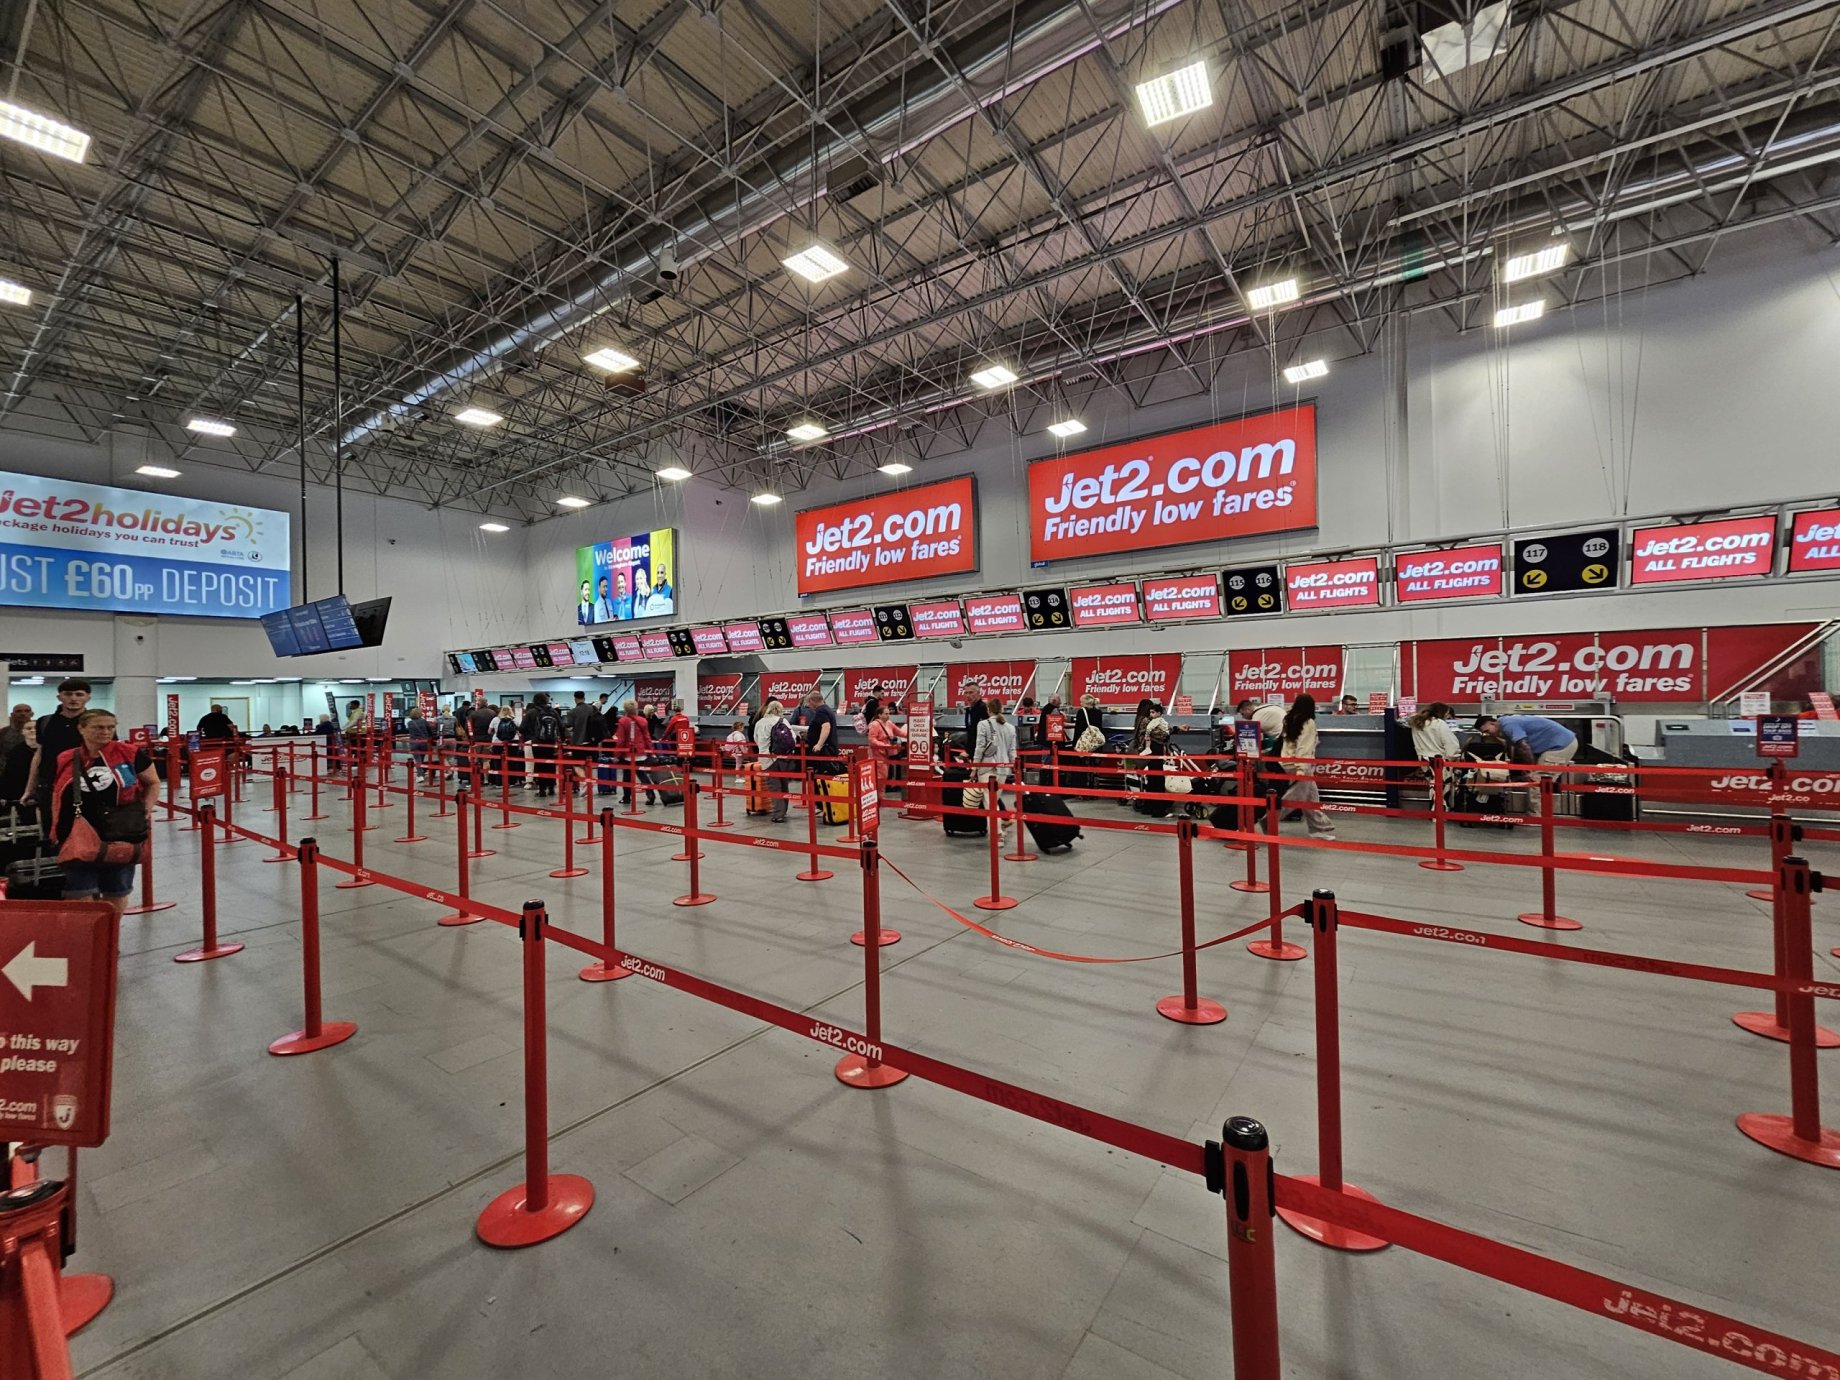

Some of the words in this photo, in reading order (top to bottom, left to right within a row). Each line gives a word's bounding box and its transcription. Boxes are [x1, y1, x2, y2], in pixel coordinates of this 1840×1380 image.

[1045, 439, 1295, 514] Jet2.com
[1043, 505, 1147, 542] Friendly
[1153, 500, 1203, 526] low
[1212, 485, 1293, 517] fares
[0, 519, 48, 532] ckage
[52, 523, 111, 539] holidays
[115, 532, 138, 541] you
[142, 535, 166, 544] can
[169, 537, 199, 548] trust
[806, 503, 961, 555] Jet2.com
[1585, 542, 1607, 553] 118
[1636, 531, 1771, 557] Jet2.com
[594, 543, 650, 566] Welcome
[805, 550, 871, 577] Friendly
[874, 546, 906, 567] low
[911, 539, 960, 561] fares
[1525, 548, 1546, 558] 117
[1399, 558, 1499, 579] Jet2.com
[1645, 560, 1677, 572] ALL
[1681, 552, 1757, 569] FLIGHTS
[1230, 579, 1245, 587] 115
[1256, 577, 1272, 585] 116
[1289, 569, 1375, 590] Jet2.com
[1406, 582, 1431, 592] ALL
[1433, 575, 1491, 590] FLIGHTS
[162, 568, 279, 609] DEPOSIT
[1146, 583, 1216, 601] Jet2.com
[1296, 591, 1317, 601] ALL
[1320, 586, 1369, 599] FLIGHTS
[1073, 593, 1135, 607] Jet2.com
[1152, 603, 1171, 612] ALL
[1172, 600, 1211, 611] FLIGHTS
[913, 609, 960, 622] Jet2.com
[968, 603, 1020, 617] Jet2.com
[1080, 609, 1095, 618] ALL
[1096, 606, 1131, 616] FLIGHTS
[791, 623, 827, 632] Jet2.com
[832, 618, 873, 630] Jet2.com
[931, 621, 958, 629] FLIGHTS
[974, 618, 987, 626] ALL
[988, 616, 1017, 625] FLIGHTS
[1453, 642, 1694, 674] Jet2.com
[1085, 668, 1166, 684] Jet2.com
[1234, 663, 1337, 680] Jet2.com
[854, 678, 907, 690] Jet2com
[958, 674, 1022, 687] Jet2.com
[1234, 680, 1280, 691] Friendly
[1281, 680, 1302, 689] low
[1305, 679, 1336, 688] fares
[1452, 675, 1553, 697] Friendly
[1559, 674, 1608, 692] low
[1616, 673, 1692, 693] fares
[987, 687, 1000, 695] low
[1002, 686, 1022, 695] fares
[1085, 684, 1121, 695] Friendly
[1122, 684, 1139, 692] low
[1141, 683, 1165, 692] fares
[168, 697, 178, 738] Jet2.com
[135, 731, 145, 740] C
[1711, 775, 1840, 793] Jet2.co
[1320, 803, 1356, 812] Jet2.com
[1480, 814, 1524, 823] Jet2.com
[1686, 824, 1741, 834] Jet2.com
[753, 837, 779, 848] Jet2.com
[621, 954, 666, 982] Jet2.com
[10, 1034, 41, 1050] this
[46, 1038, 80, 1055] way
[810, 1021, 883, 1061] Jet2.com
[0, 1055, 57, 1073] please
[0, 1098, 37, 1113] 2.com
